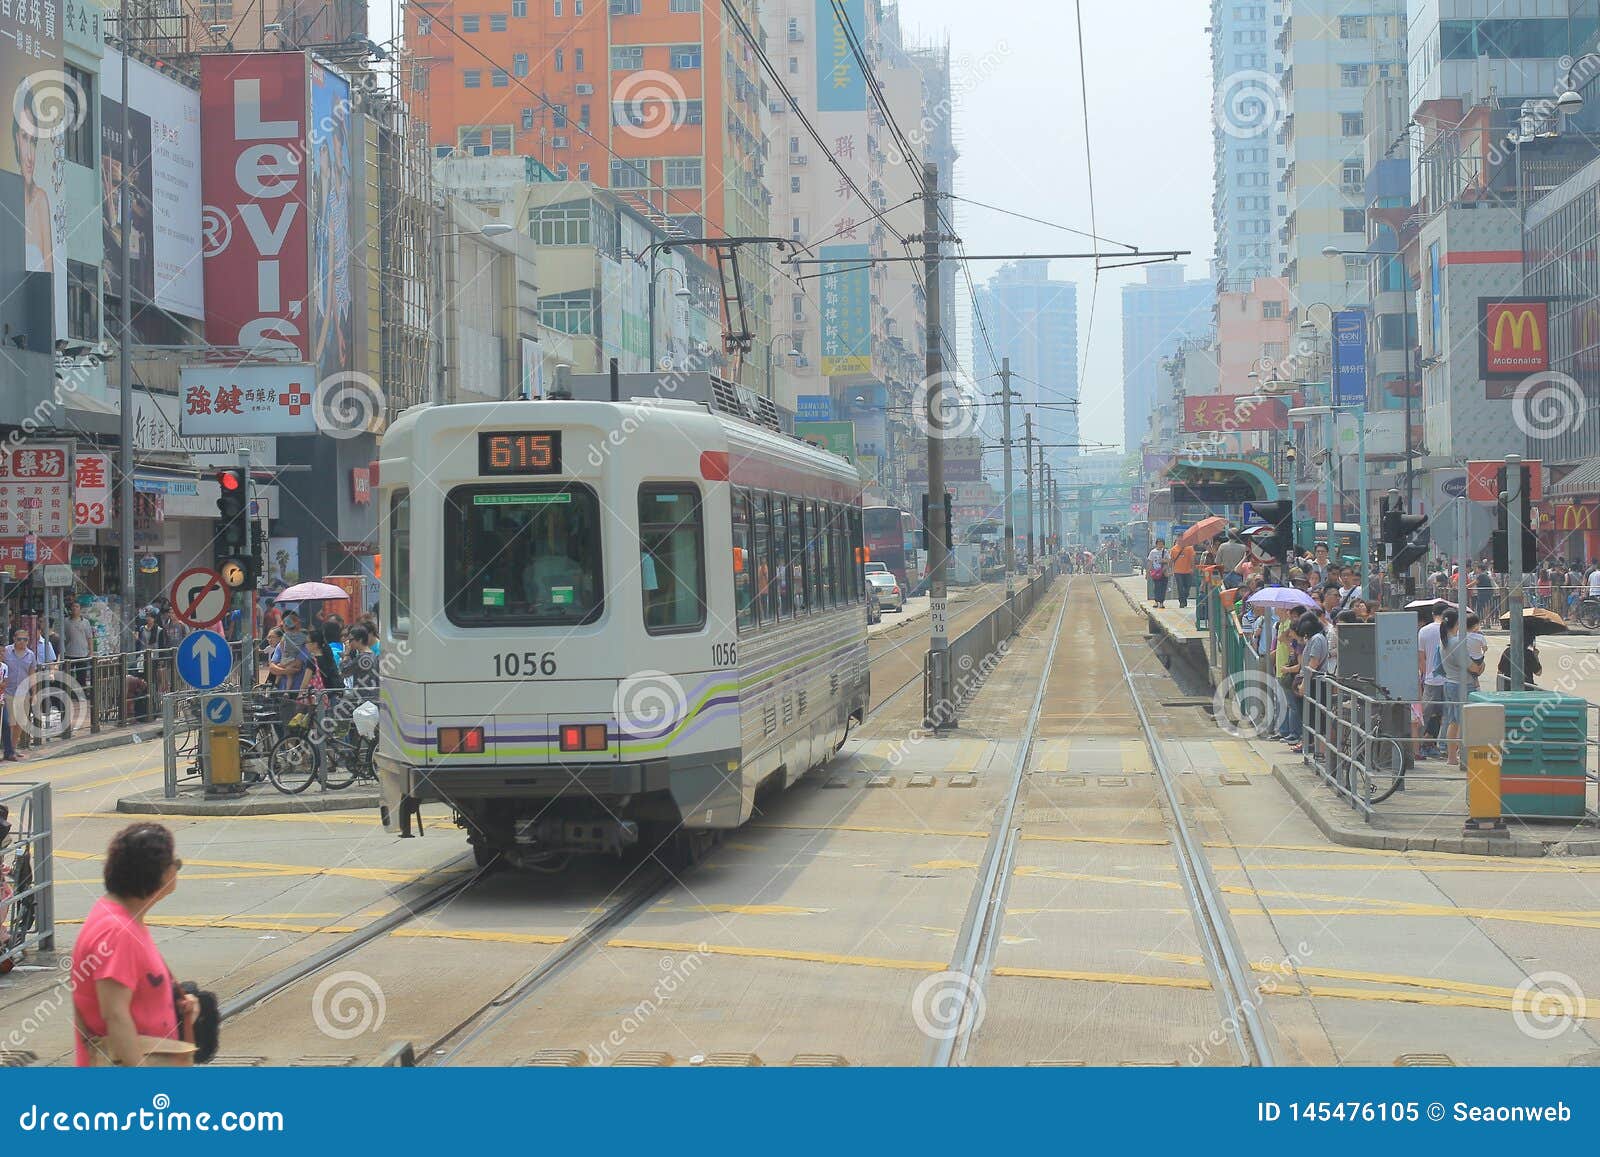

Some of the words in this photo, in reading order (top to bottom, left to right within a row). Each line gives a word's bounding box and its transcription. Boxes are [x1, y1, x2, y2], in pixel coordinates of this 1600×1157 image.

[490, 434, 552, 468] 615
[75, 502, 105, 525] 93
[493, 652, 557, 677] 1056
[711, 642, 737, 667] 1056
